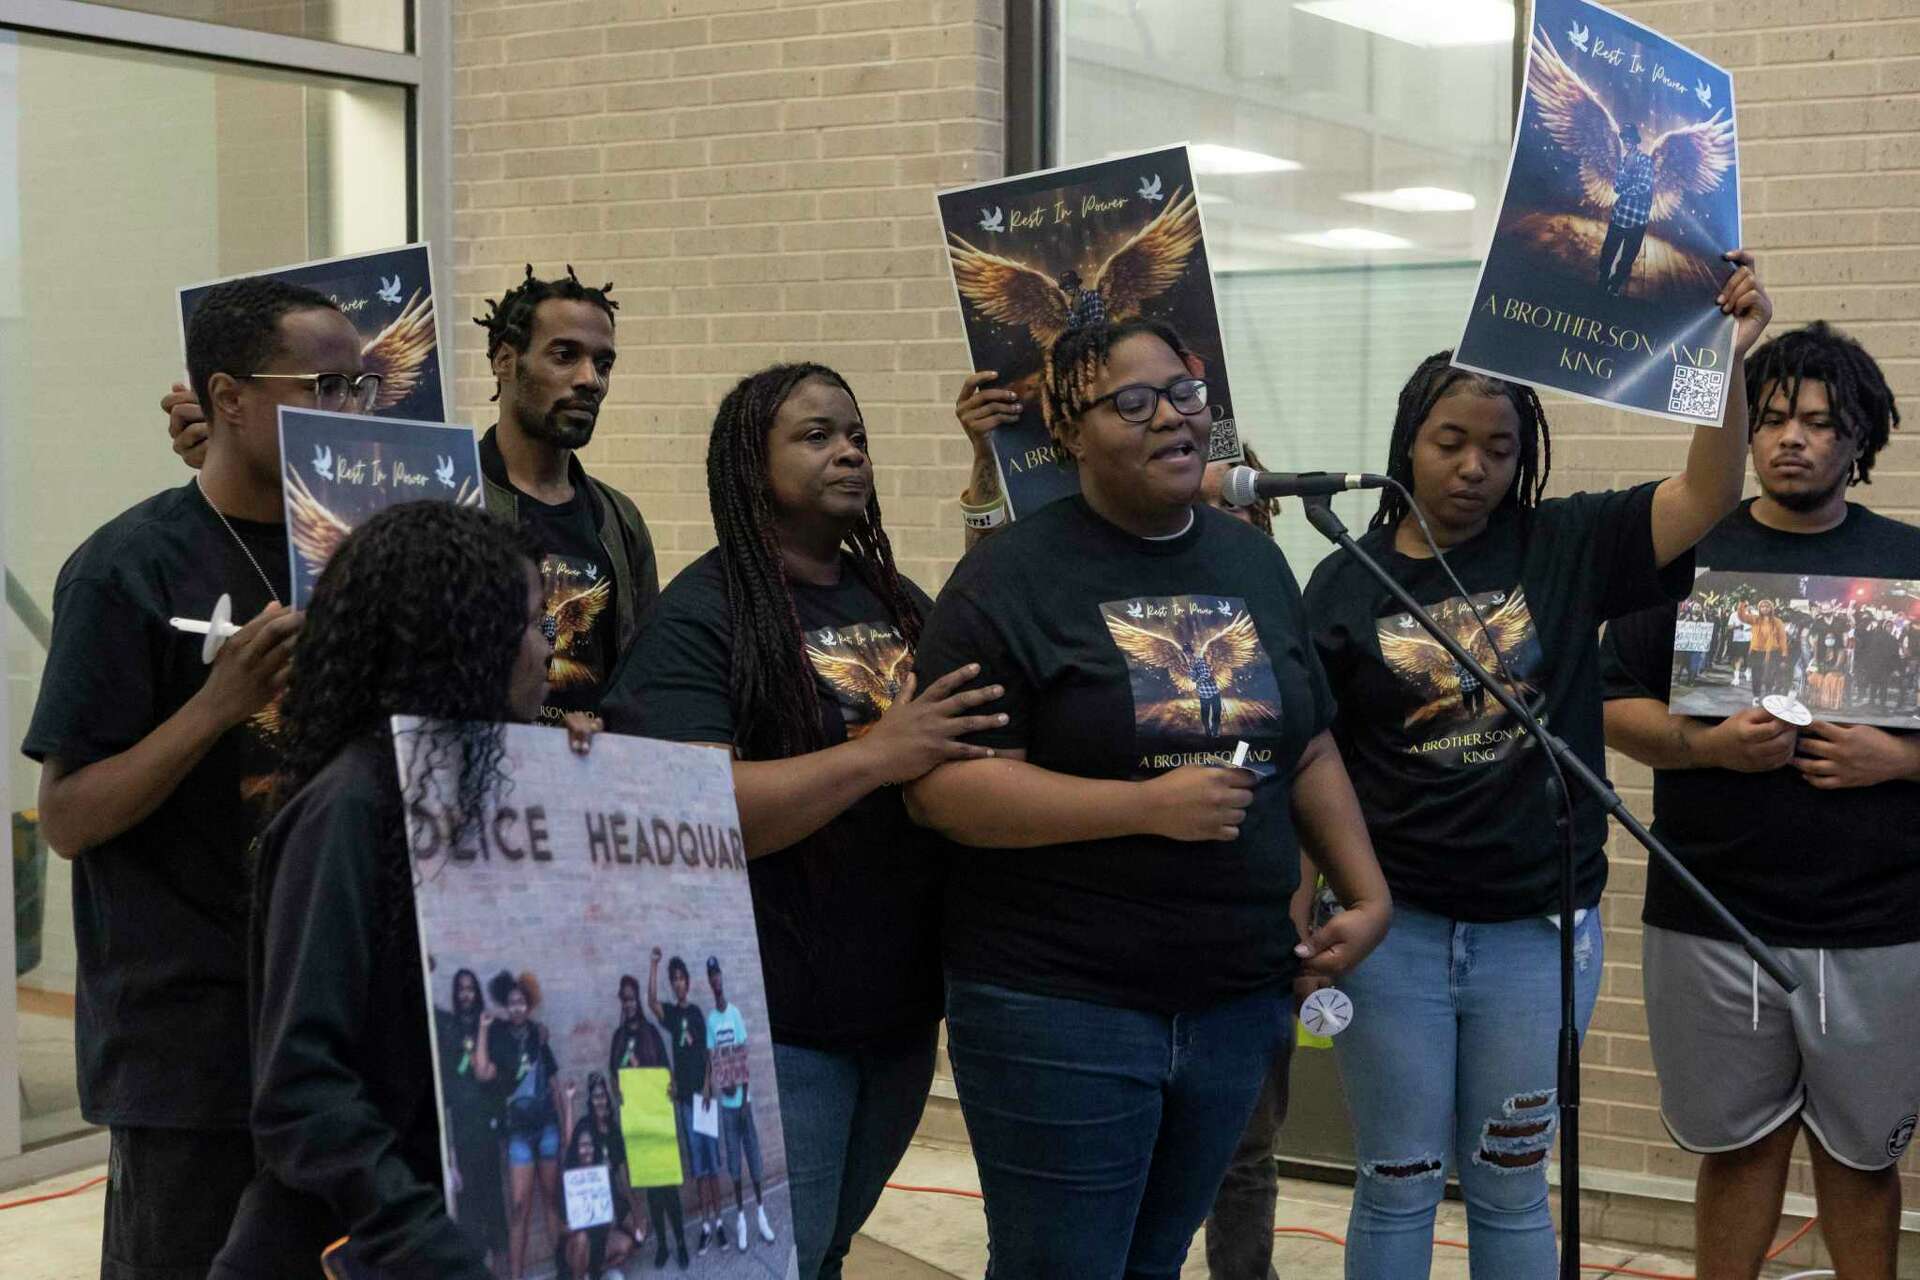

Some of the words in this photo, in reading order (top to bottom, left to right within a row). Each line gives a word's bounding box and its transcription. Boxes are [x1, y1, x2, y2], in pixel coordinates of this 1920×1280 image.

[1591, 36, 1626, 66] Rest
[1629, 54, 1646, 73] In
[1652, 63, 1689, 94] Power
[1009, 205, 1048, 232] Rest
[1054, 200, 1073, 224] In
[1081, 194, 1128, 218] Power
[1481, 294, 1497, 316] A
[1664, 341, 1718, 370] AND
[1559, 346, 1616, 380] KING
[336, 454, 367, 486] Rest
[1008, 457, 1023, 477] A
[1139, 756, 1151, 769] A
[1409, 744, 1419, 754] A
[1463, 747, 1496, 764] KING
[584, 810, 745, 871] HEADQUAR
